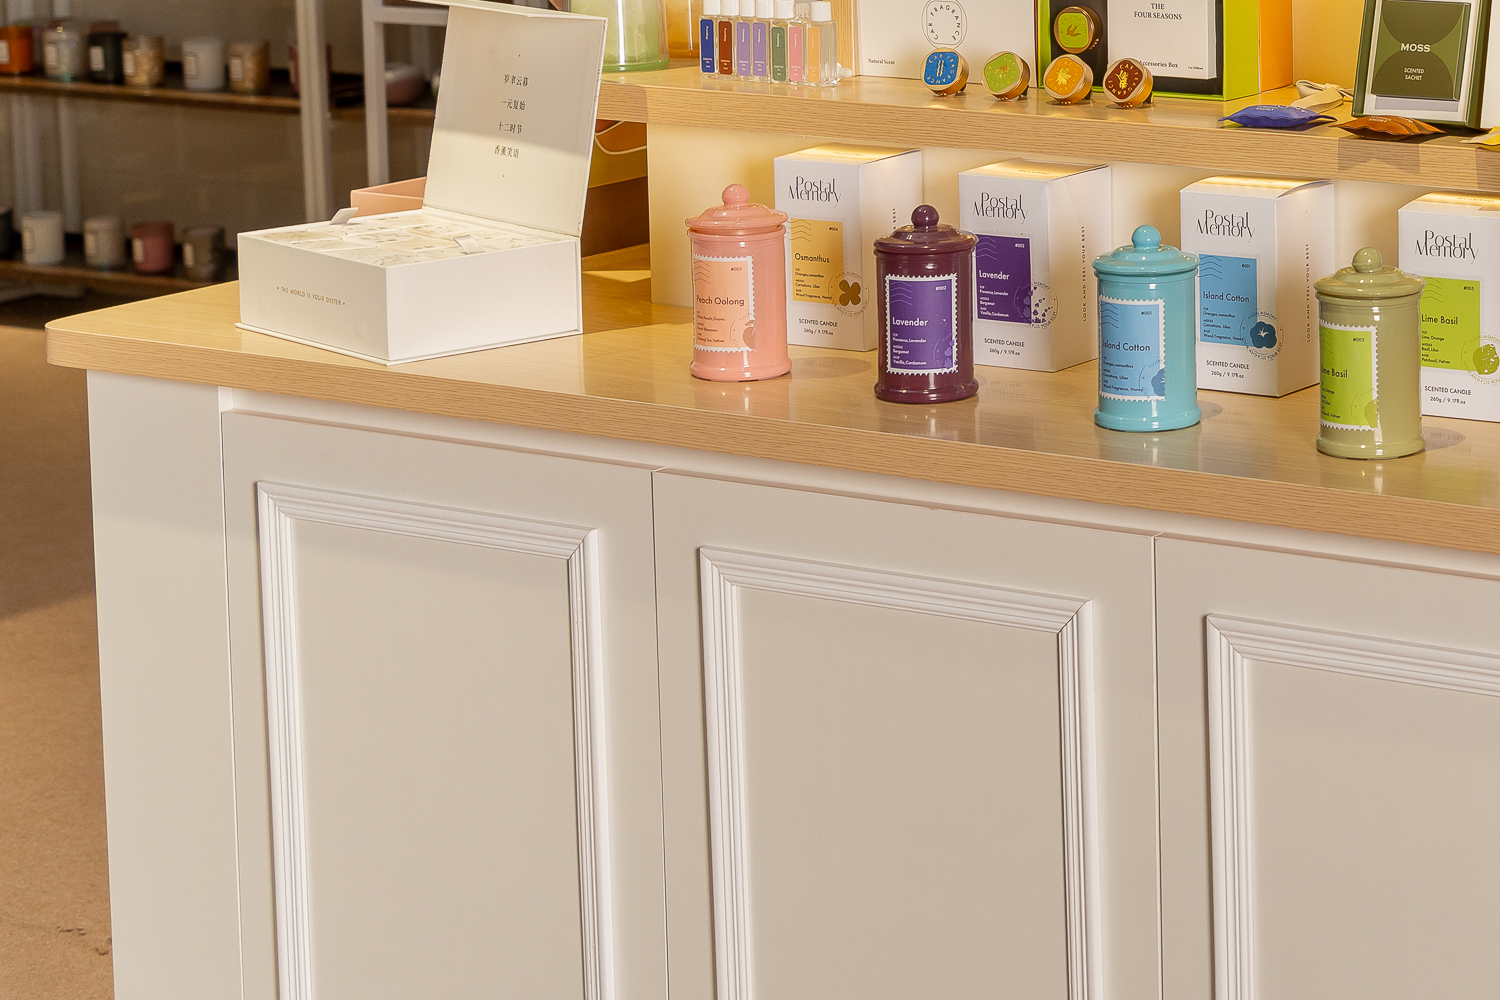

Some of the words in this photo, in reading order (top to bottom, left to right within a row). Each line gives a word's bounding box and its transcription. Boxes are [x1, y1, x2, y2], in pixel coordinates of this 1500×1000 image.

[1153, 12, 1182, 20] SEASONS
[1401, 43, 1431, 52] MOSS
[1140, 60, 1167, 68] Accessories
[501, 99, 525, 110] 一元复始
[498, 121, 522, 134] 十二时节
[796, 176, 835, 194] Postal
[788, 185, 841, 207] Memory
[982, 192, 1021, 210] Postal
[973, 201, 1028, 224] Memory
[1205, 210, 1248, 229] Postal
[1196, 219, 1255, 243] Memory
[1425, 230, 1471, 250] Postal
[1415, 239, 1479, 265] Memory
[795, 253, 829, 263] Osmanthus
[979, 270, 1009, 280] Lavender
[290, 289, 305, 297] WORLD
[326, 297, 341, 305] OYSTER
[697, 295, 712, 304] Peach
[715, 297, 745, 306] Oolong
[1203, 291, 1223, 300] Island
[1226, 293, 1249, 302] Cotton
[893, 317, 928, 326] Lavender
[1422, 314, 1438, 323] Lime
[1441, 316, 1458, 325] Basil
[1103, 340, 1120, 350] Island
[1123, 342, 1150, 351] Cotton
